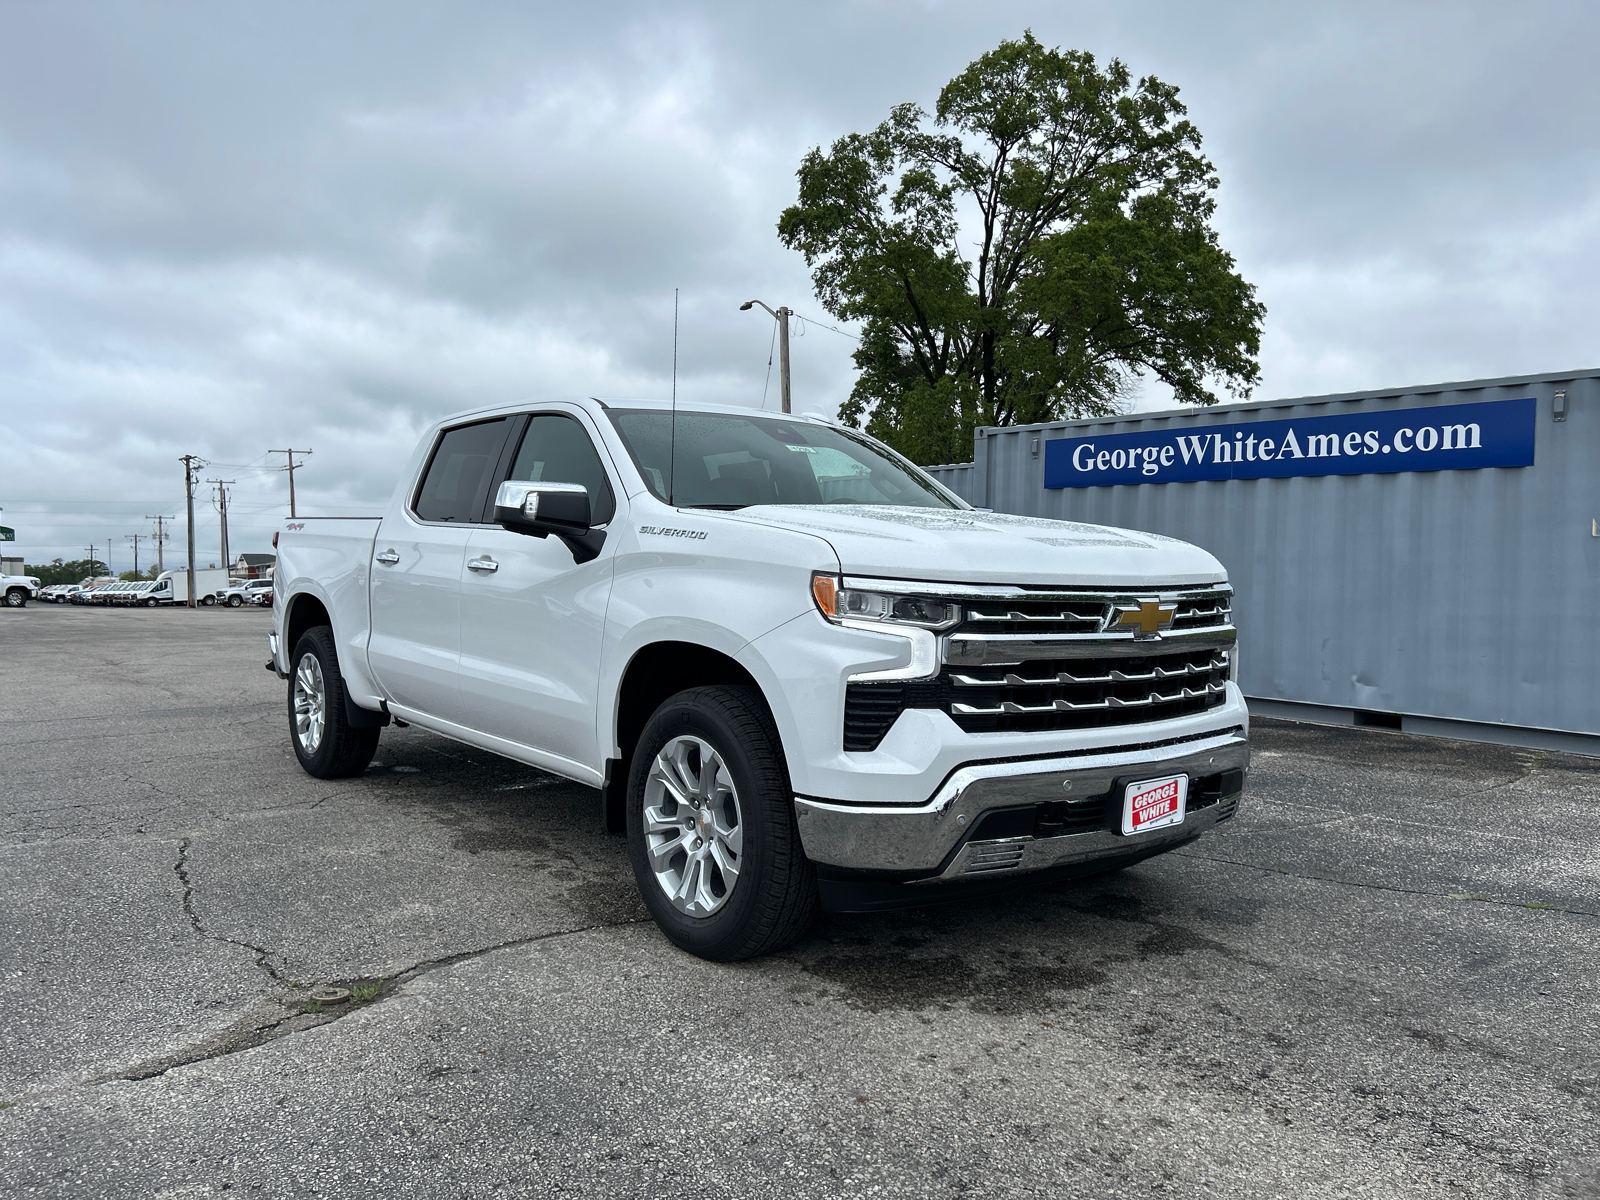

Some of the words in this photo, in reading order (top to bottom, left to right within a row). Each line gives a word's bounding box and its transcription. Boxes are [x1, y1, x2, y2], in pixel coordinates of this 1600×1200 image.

[1072, 422, 1482, 475] GeorgeWhiteAmes.com
[639, 525, 708, 540] SILVERADO
[1134, 783, 1175, 809] GEORGE
[1139, 799, 1171, 823] WHITE
